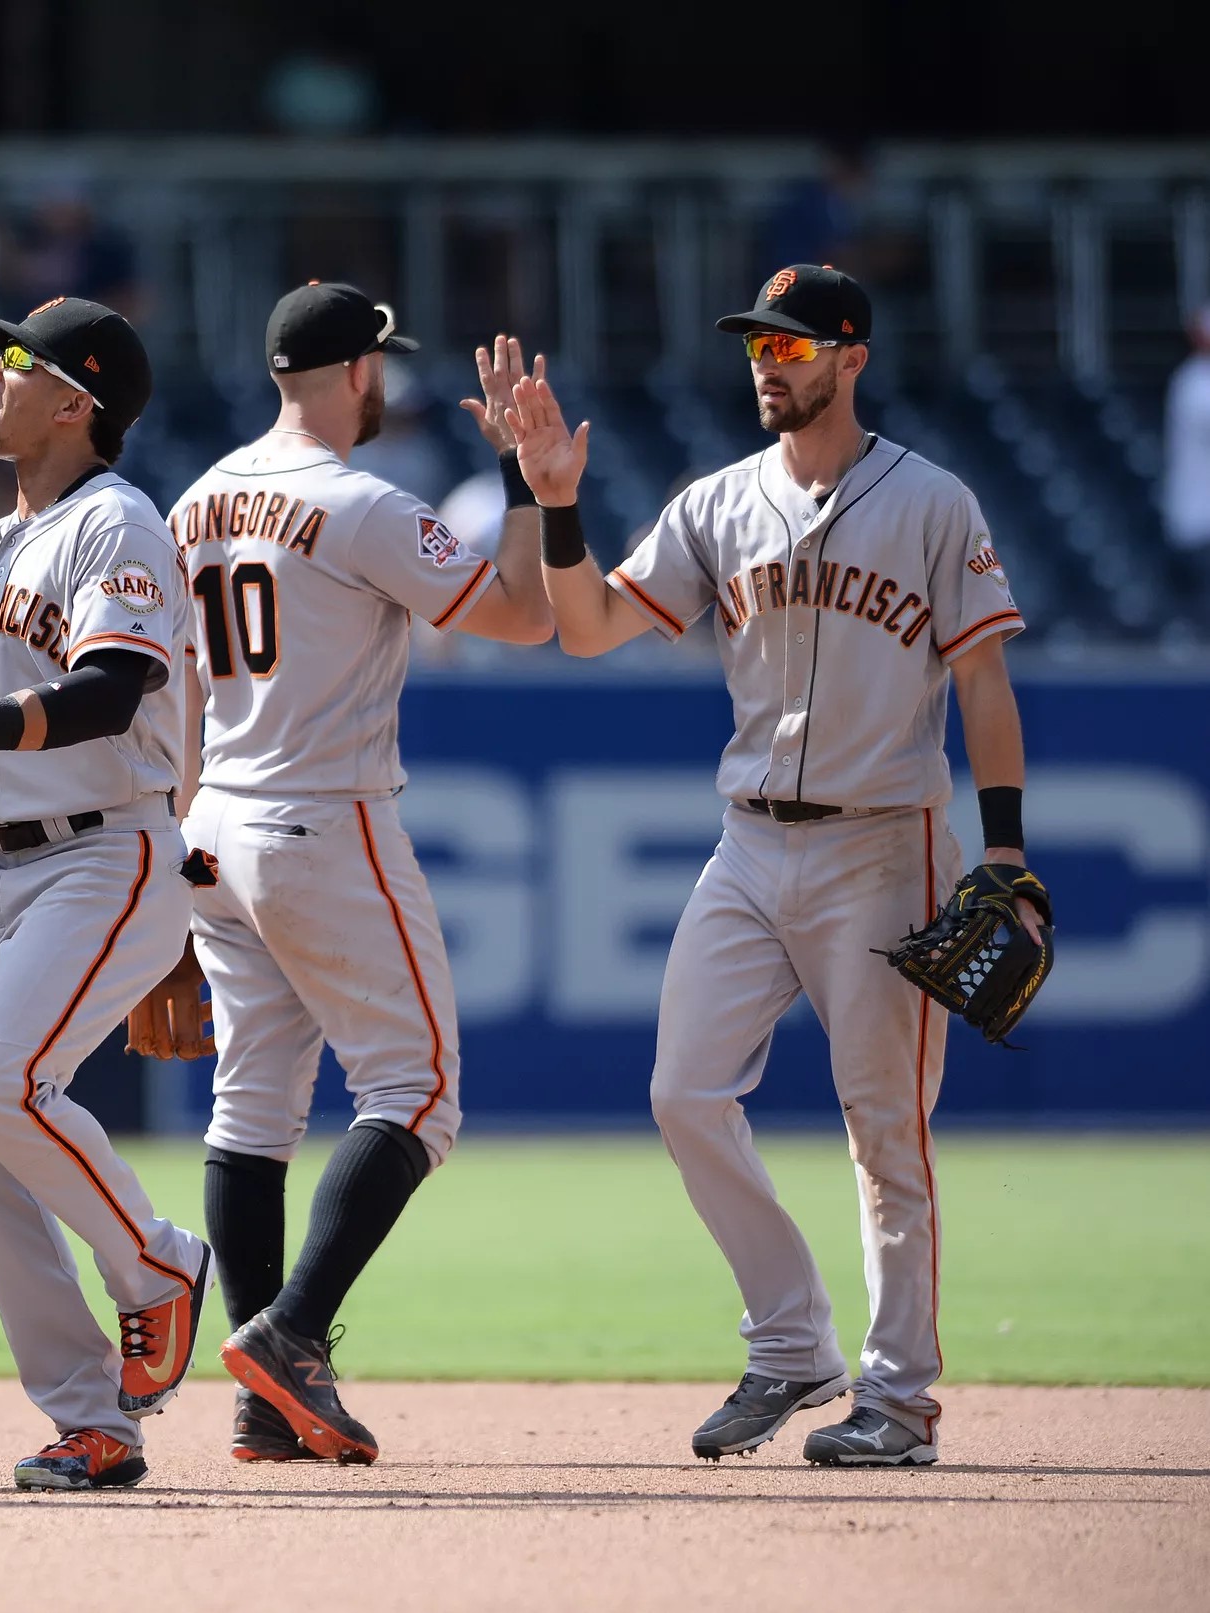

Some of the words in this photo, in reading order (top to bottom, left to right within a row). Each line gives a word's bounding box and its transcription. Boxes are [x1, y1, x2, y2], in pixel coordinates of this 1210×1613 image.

[423, 522, 451, 556] 60
[100, 577, 164, 608] GIANTS
[192, 561, 282, 680] 10
[716, 575, 752, 639] AN
[749, 559, 932, 649] FRANCISCO
